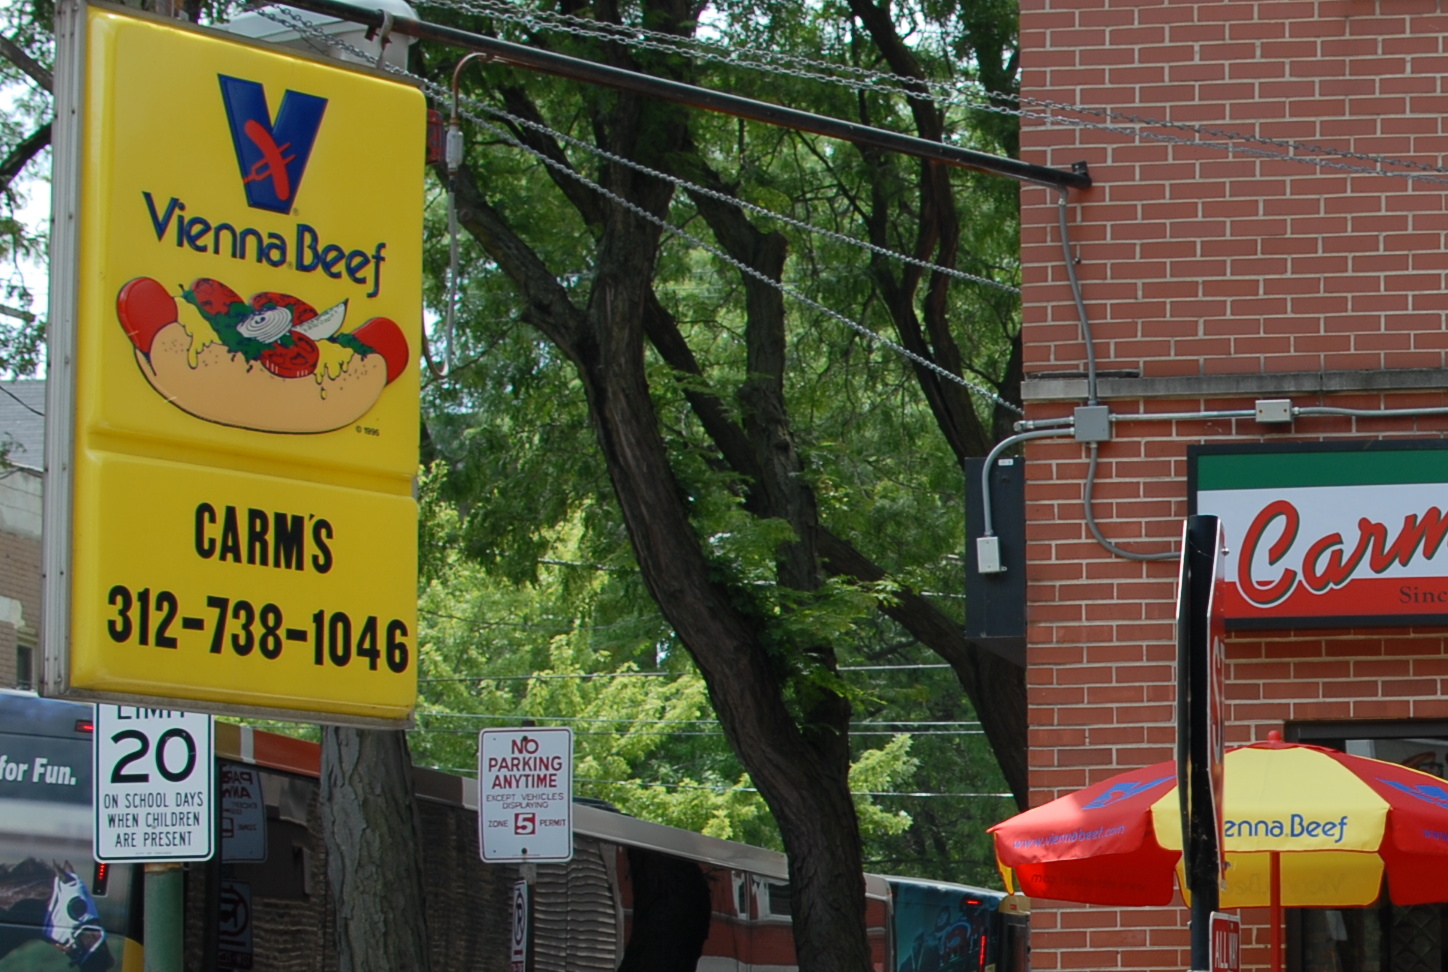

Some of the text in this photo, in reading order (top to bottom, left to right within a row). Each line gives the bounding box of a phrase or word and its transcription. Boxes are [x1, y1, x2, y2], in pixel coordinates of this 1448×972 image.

[141, 190, 387, 298] Vienna Beef
[194, 501, 334, 574] CARM'S
[107, 584, 410, 674] 312-738-1046
[110, 727, 197, 784] 20
[511, 738, 539, 755] NO
[0, 755, 77, 785] for Fun.
[488, 756, 563, 772] PARKING
[491, 773, 558, 789] ANYTIME
[104, 793, 119, 809] ON
[125, 792, 169, 808] SCHOOL
[175, 791, 204, 807] DAYS
[486, 792, 564, 802] EXCEPT VEHICLES
[107, 811, 200, 828] WHEN CHILDREN
[488, 813, 566, 834] ZONE 5 PERMIT
[1224, 813, 1348, 844] enna Beef
[115, 831, 192, 847] ARE PRESENT
[1013, 824, 1126, 849] www.viennabeef.com
